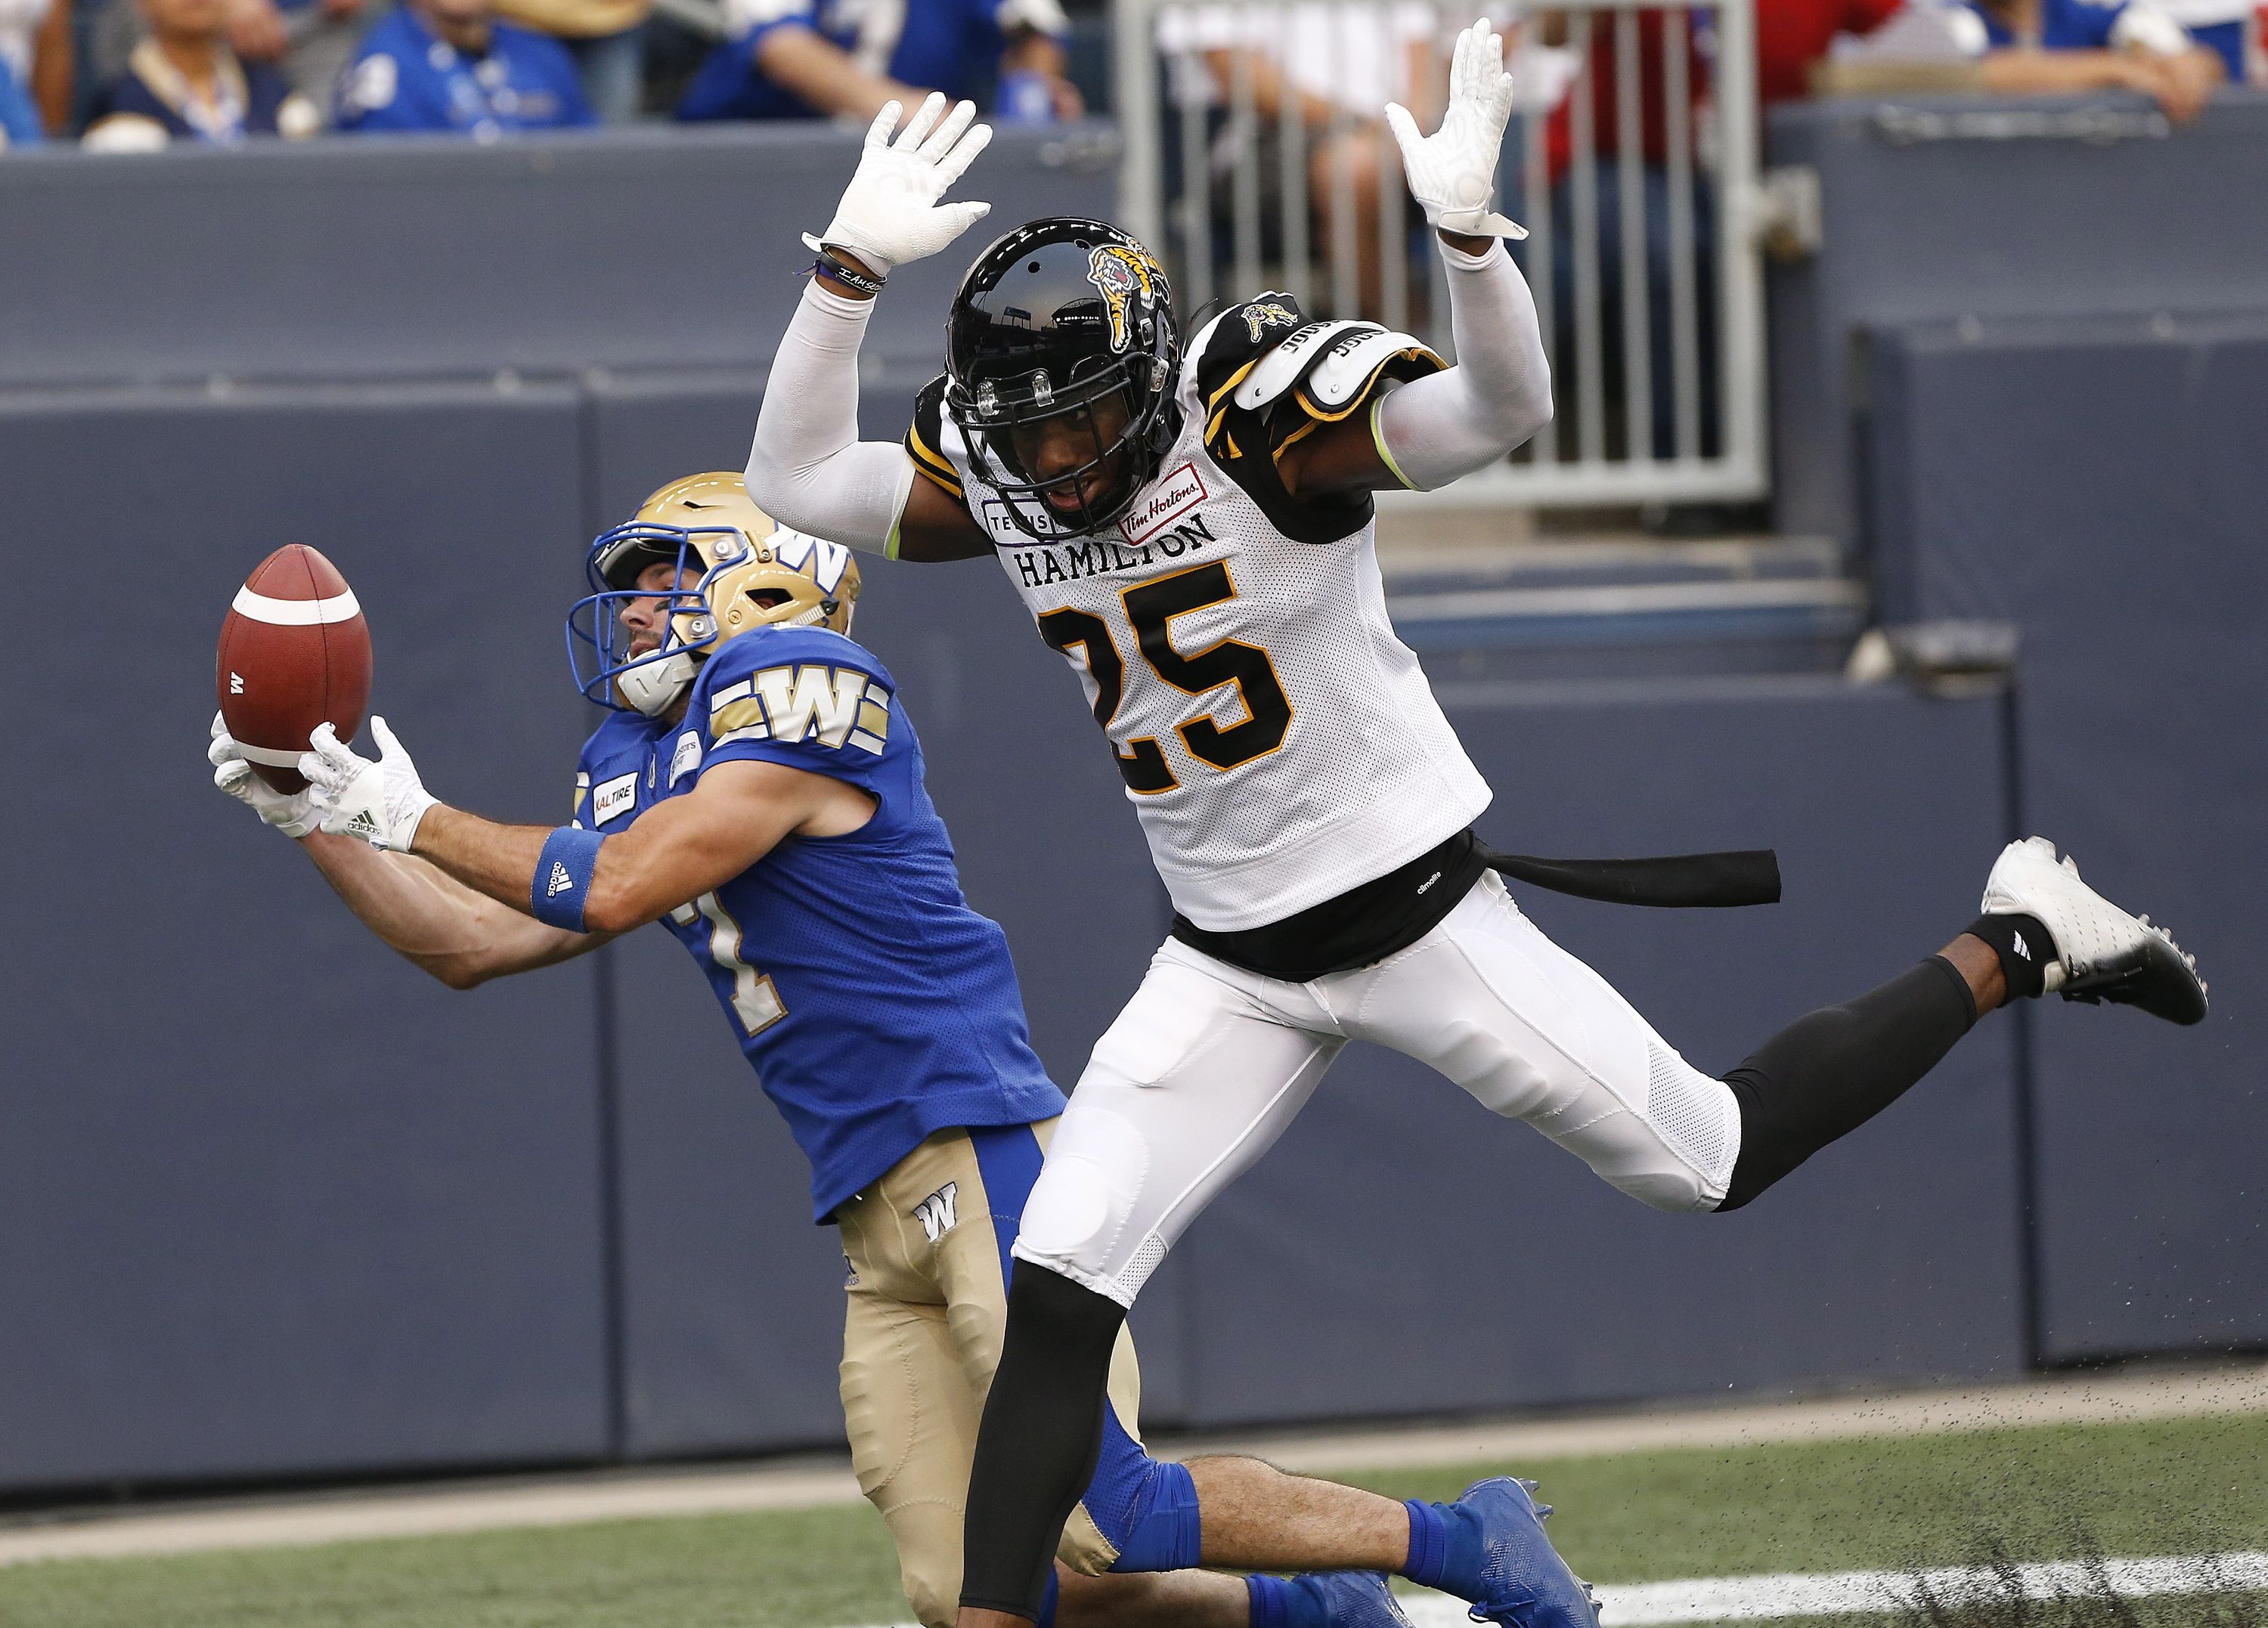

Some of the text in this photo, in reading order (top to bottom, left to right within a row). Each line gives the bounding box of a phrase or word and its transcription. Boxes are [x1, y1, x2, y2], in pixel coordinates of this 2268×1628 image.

[838, 267, 852, 280] I
[850, 274, 866, 287] AM
[990, 515, 1048, 531] TES
[1121, 511, 1149, 535] Tim
[1037, 558, 1295, 795] 25
[753, 664, 869, 749] W
[347, 822, 381, 836] adidas
[547, 861, 562, 897] adidas
[912, 1181, 958, 1245] W
